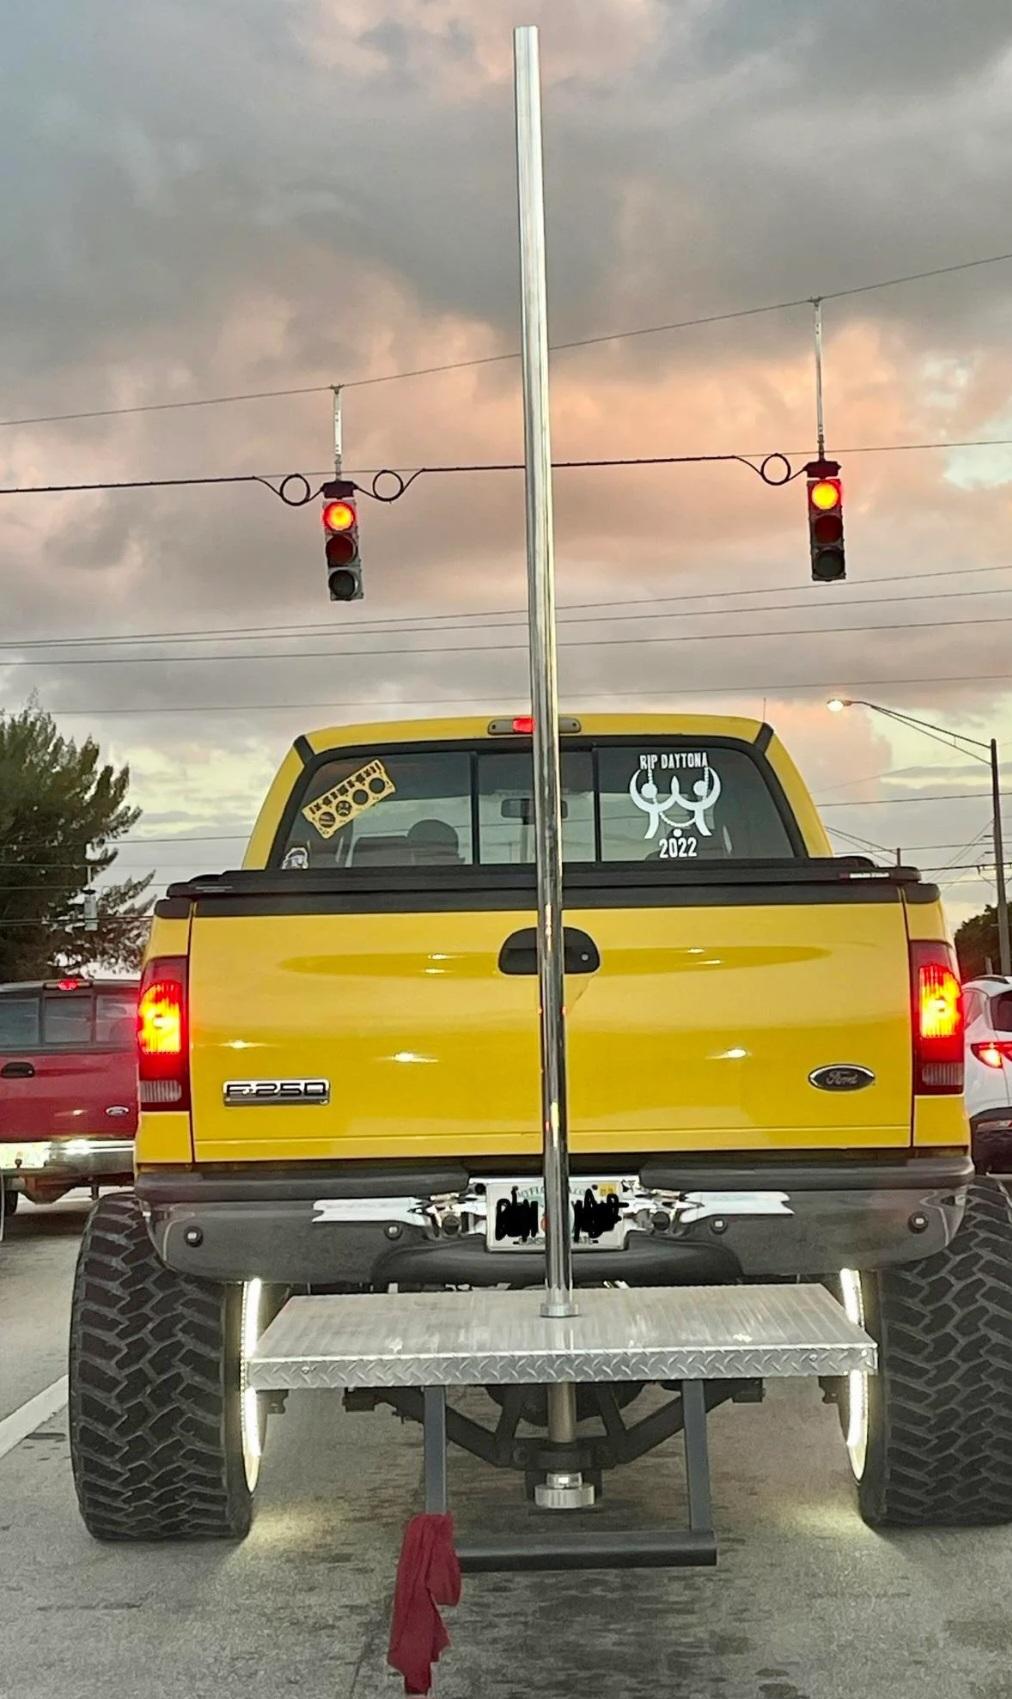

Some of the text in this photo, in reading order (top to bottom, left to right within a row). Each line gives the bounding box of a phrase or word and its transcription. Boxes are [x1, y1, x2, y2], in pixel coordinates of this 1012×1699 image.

[640, 752, 708, 769] RIP DAYTONA
[659, 837, 697, 858] 2022
[826, 1071, 858, 1085] Ford
